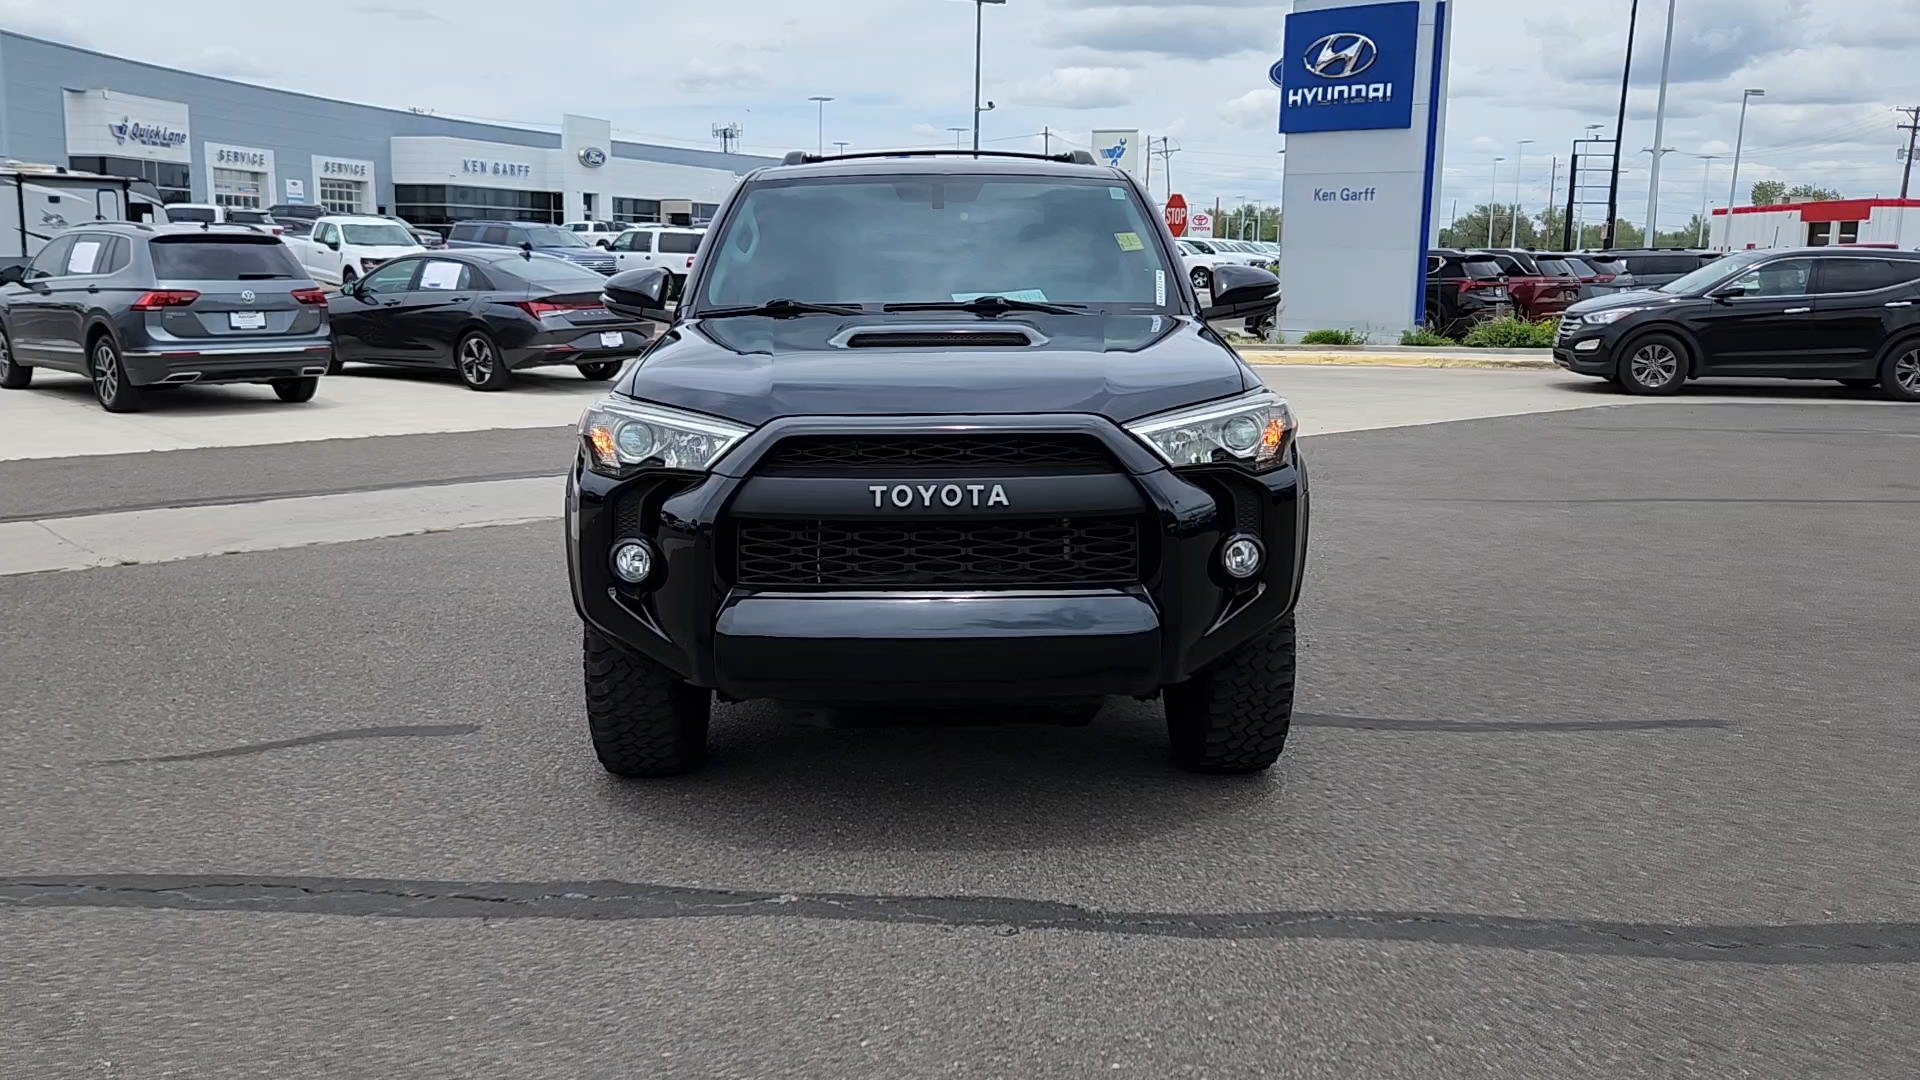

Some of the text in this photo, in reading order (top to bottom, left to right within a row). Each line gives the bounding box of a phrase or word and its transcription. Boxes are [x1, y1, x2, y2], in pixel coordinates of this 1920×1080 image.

[1288, 83, 1392, 107] HYUNDAI
[131, 122, 161, 140] Quick
[162, 127, 187, 144] Lane
[217, 149, 265, 167] SERVICE
[323, 161, 366, 177] SERVICE
[463, 159, 531, 177] KEN GARFF
[1313, 187, 1376, 202] Ken Garff
[1166, 207, 1186, 225] STOP
[869, 484, 1010, 508] TOYOTA
